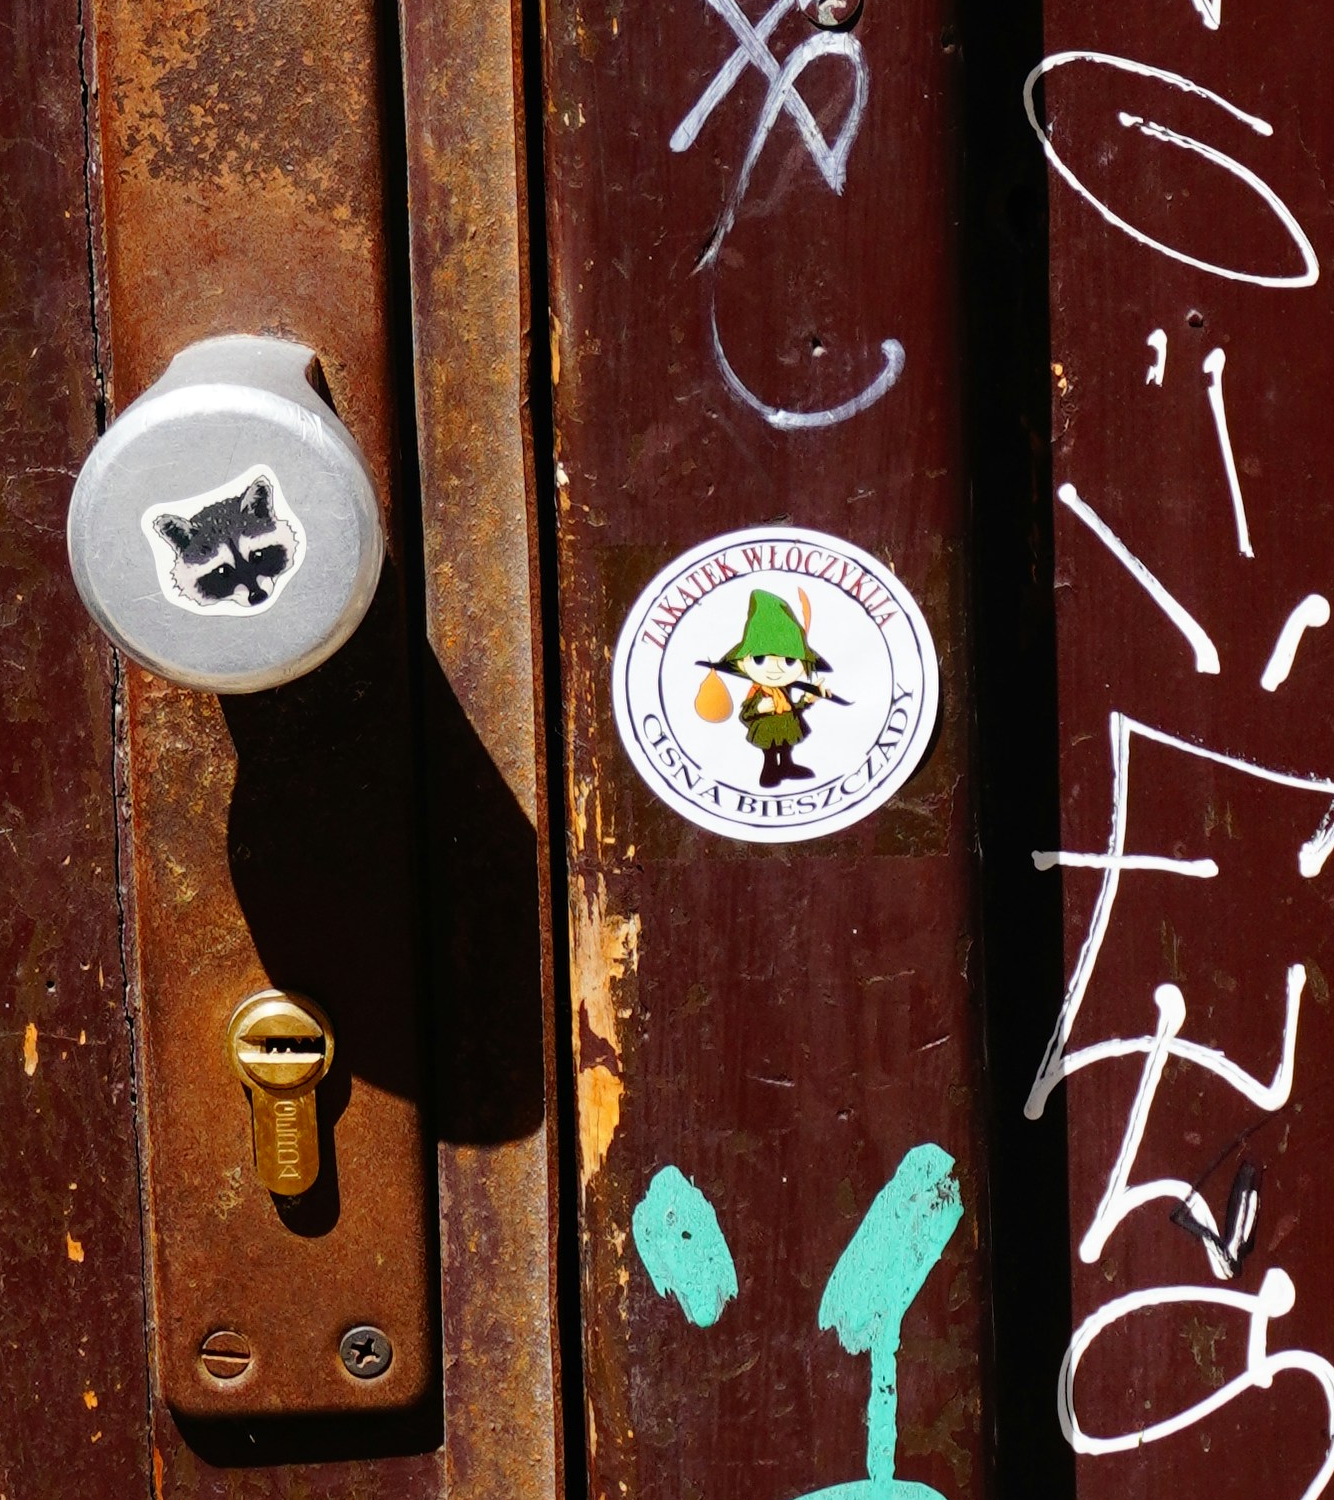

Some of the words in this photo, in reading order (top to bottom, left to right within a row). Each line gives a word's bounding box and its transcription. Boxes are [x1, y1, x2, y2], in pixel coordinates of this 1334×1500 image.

[640, 552, 740, 651] ZAKĄTEK
[741, 540, 899, 630] WŁÓCZYKIJA
[641, 712, 722, 810] CISNA
[735, 682, 915, 819] BIESZCZADY
[273, 1099, 302, 1180] GERDA
